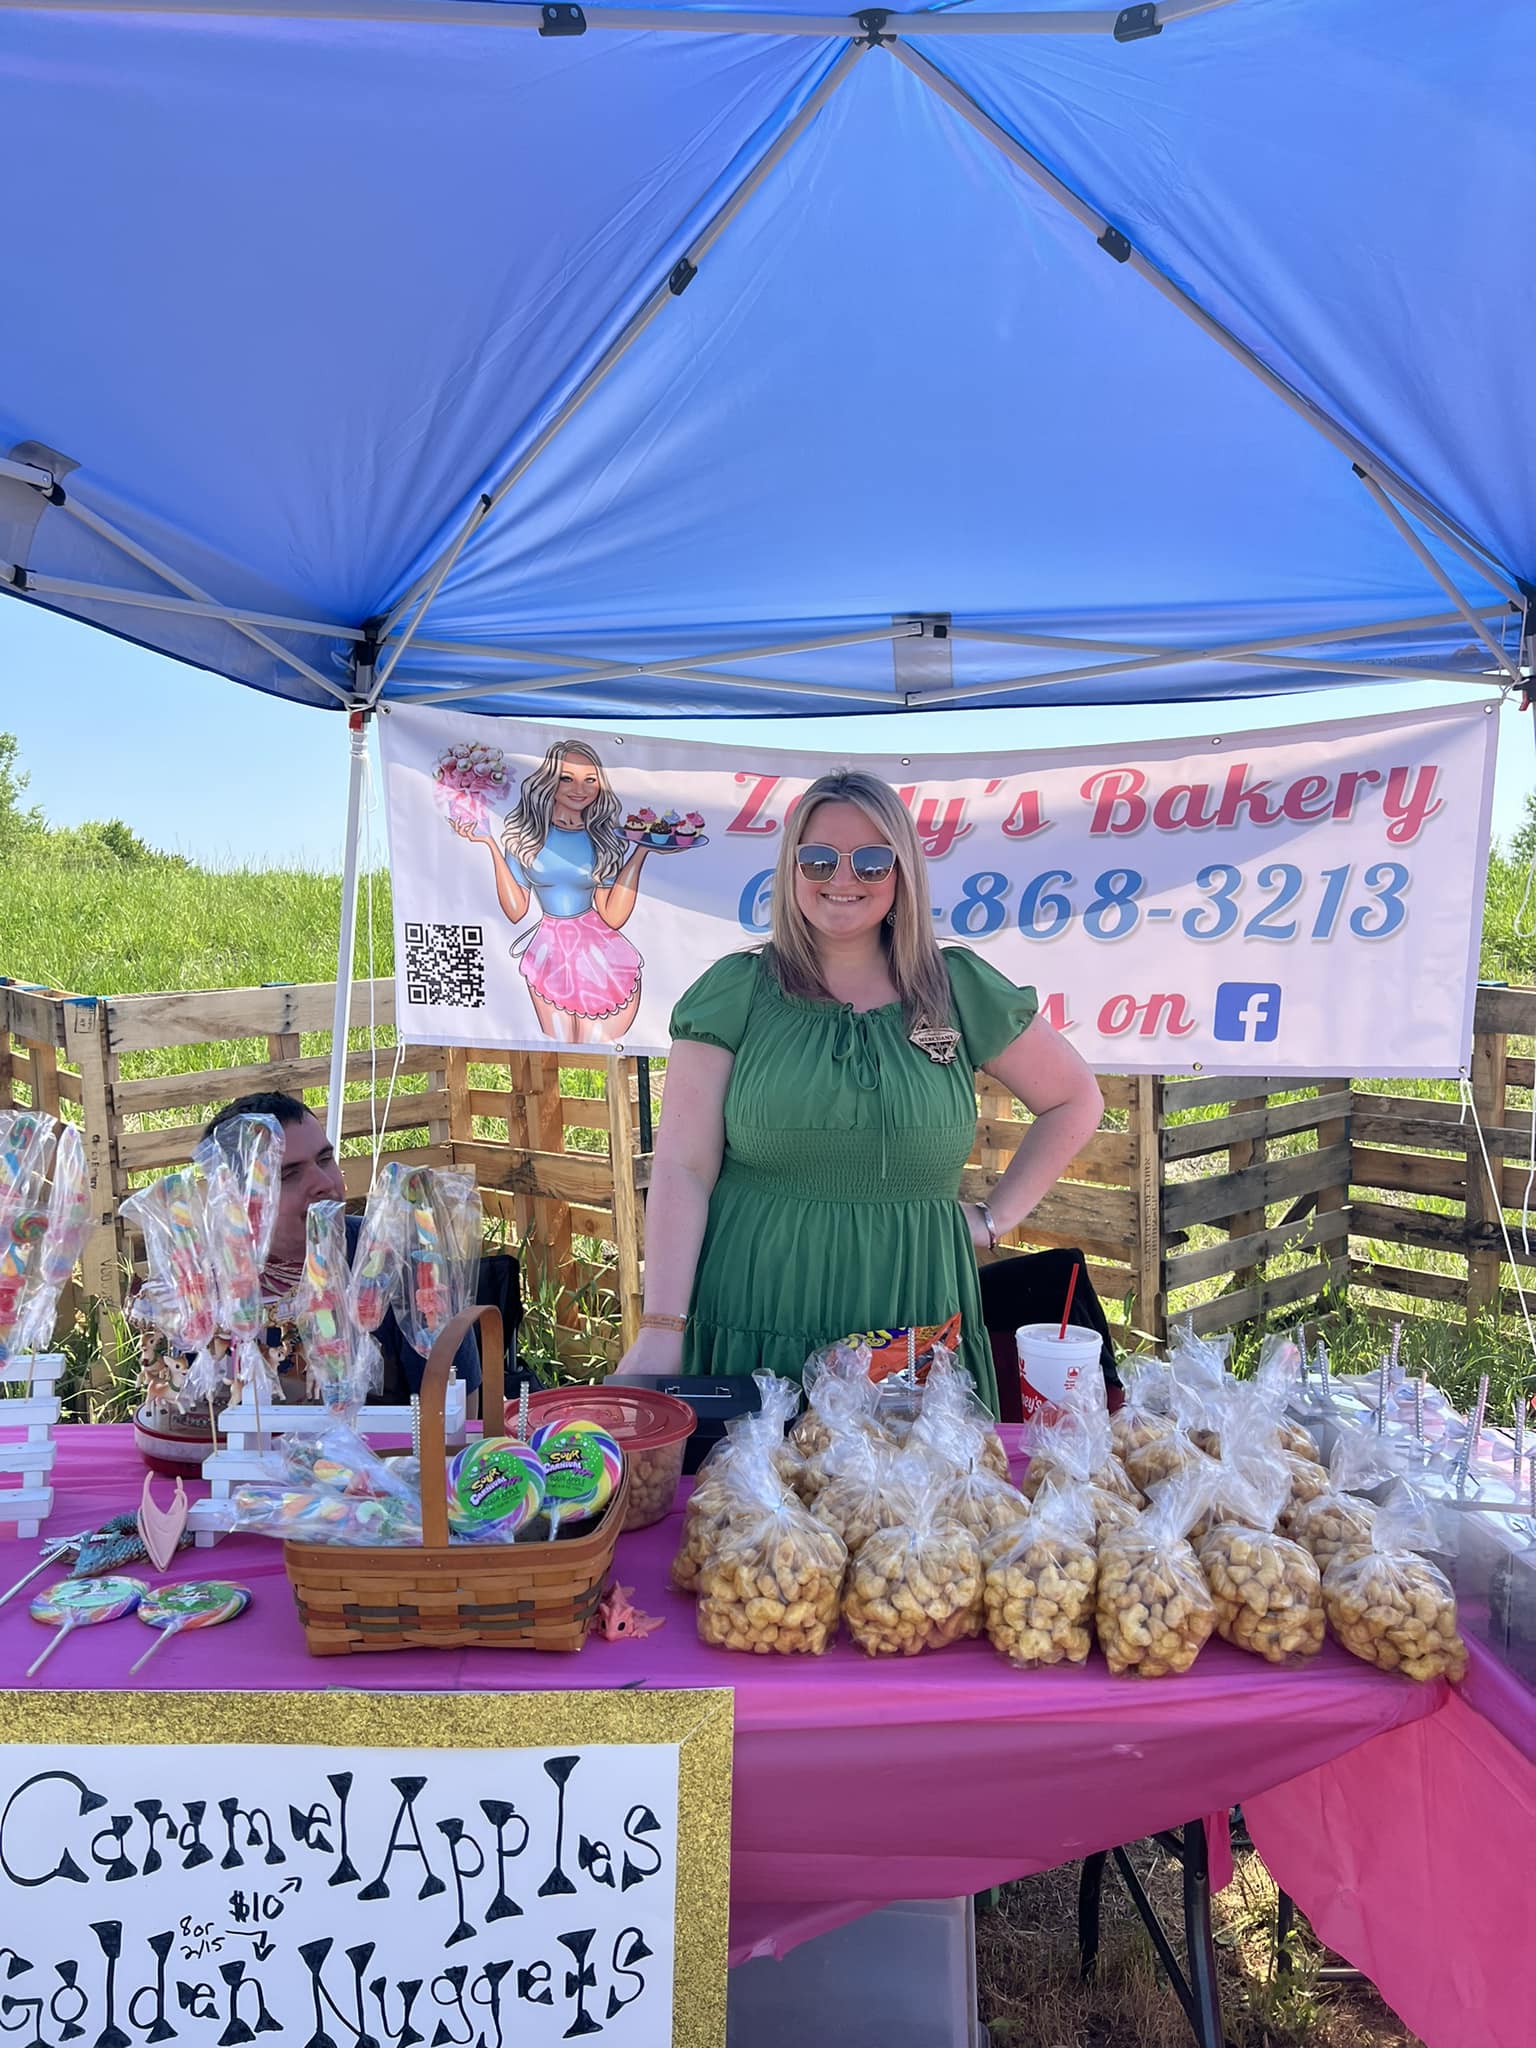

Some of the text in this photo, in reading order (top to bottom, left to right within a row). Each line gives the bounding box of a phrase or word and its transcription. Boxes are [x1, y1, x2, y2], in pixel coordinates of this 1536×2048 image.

[1080, 763, 1443, 843] Bakery
[1096, 992, 1196, 1036] on
[549, 1449, 581, 1464] SOUR
[470, 1467, 501, 1491] SOUR
[0, 1755, 662, 1948] Caramel Apples
[229, 1890, 285, 1923] $10
[298, 1926, 654, 2048] Nuggets
